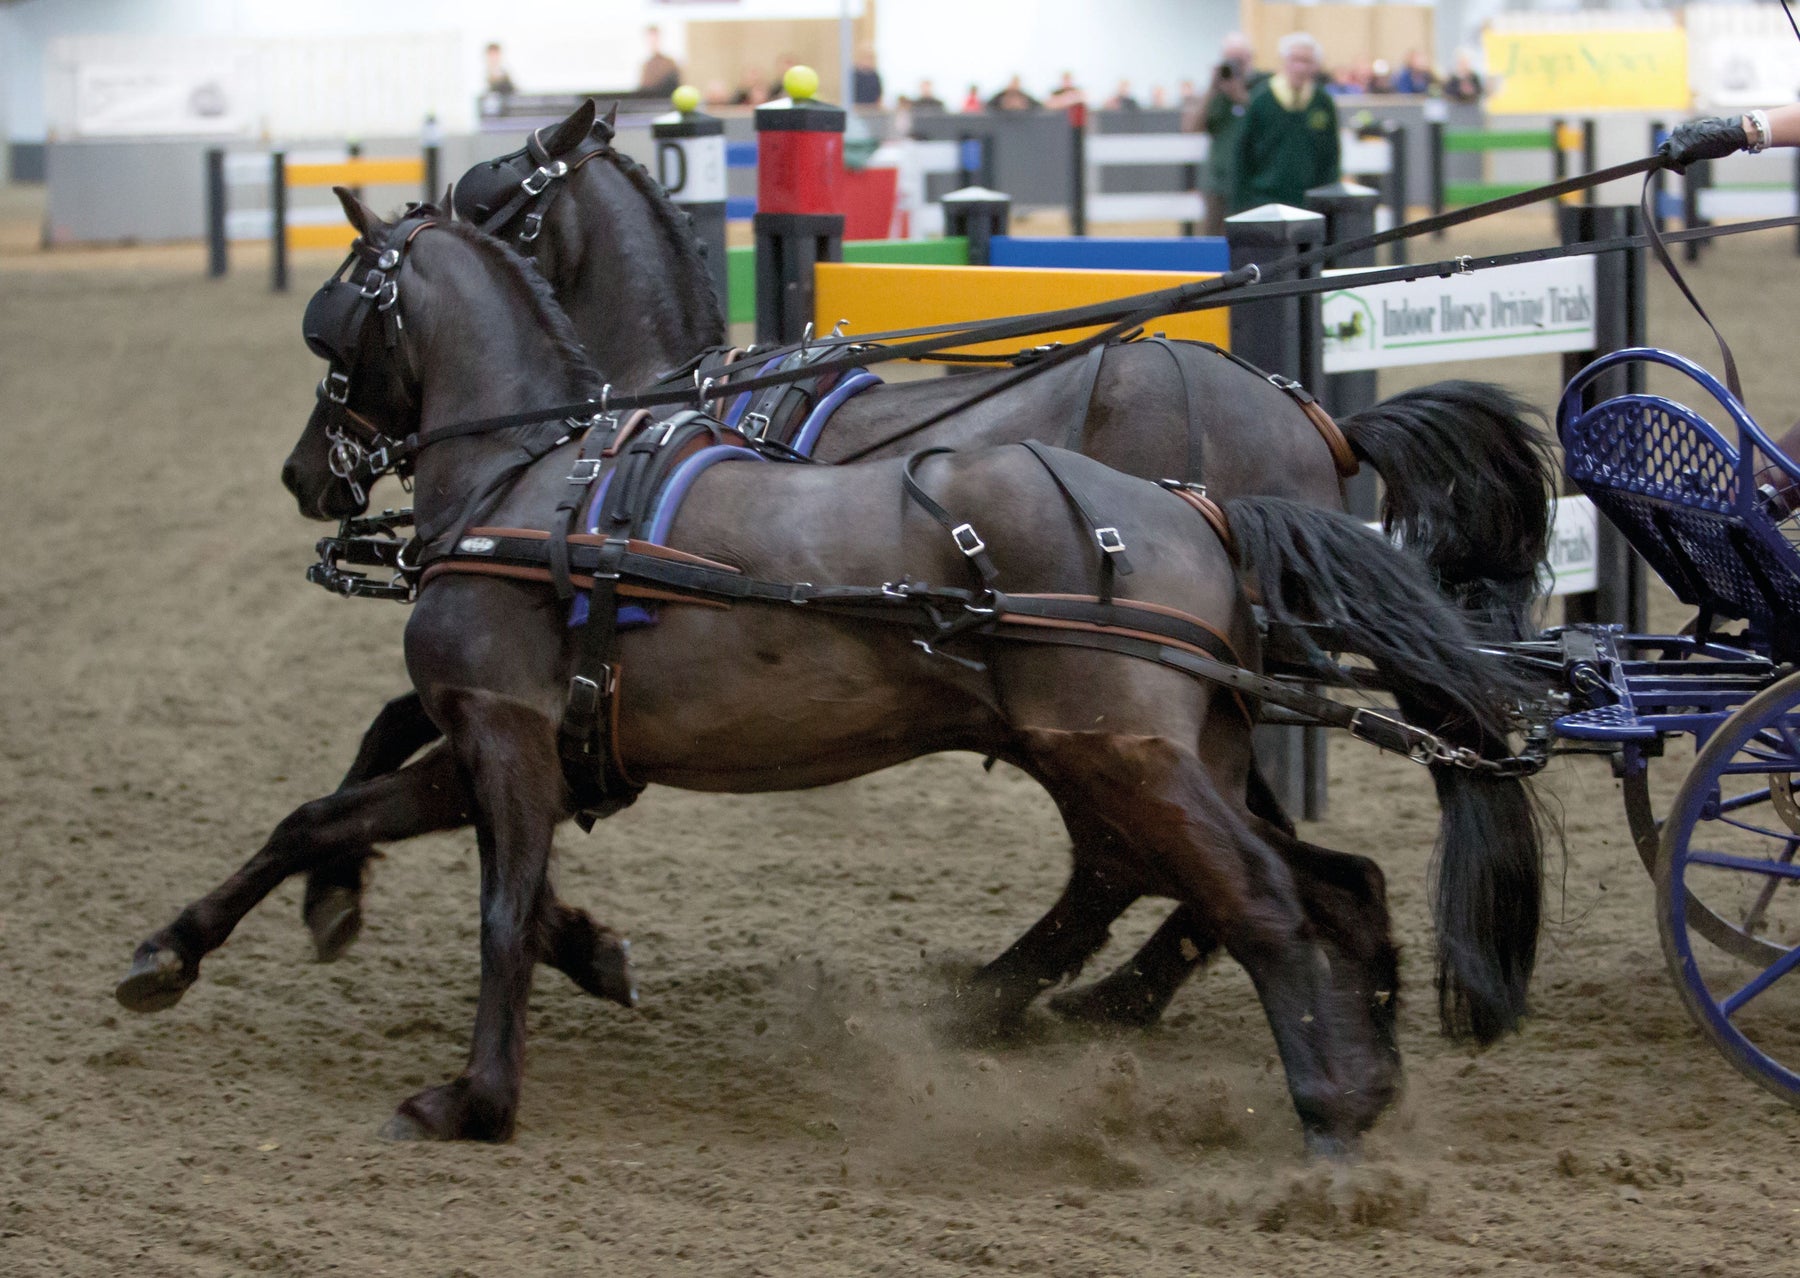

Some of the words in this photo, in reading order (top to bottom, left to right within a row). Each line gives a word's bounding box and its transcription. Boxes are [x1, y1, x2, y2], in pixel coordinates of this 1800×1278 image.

[658, 142, 687, 195] D
[1383, 297, 1436, 337] Indoor
[1440, 294, 1486, 332] Horse
[1490, 290, 1544, 329] Driving
[1548, 285, 1591, 323] Trials
